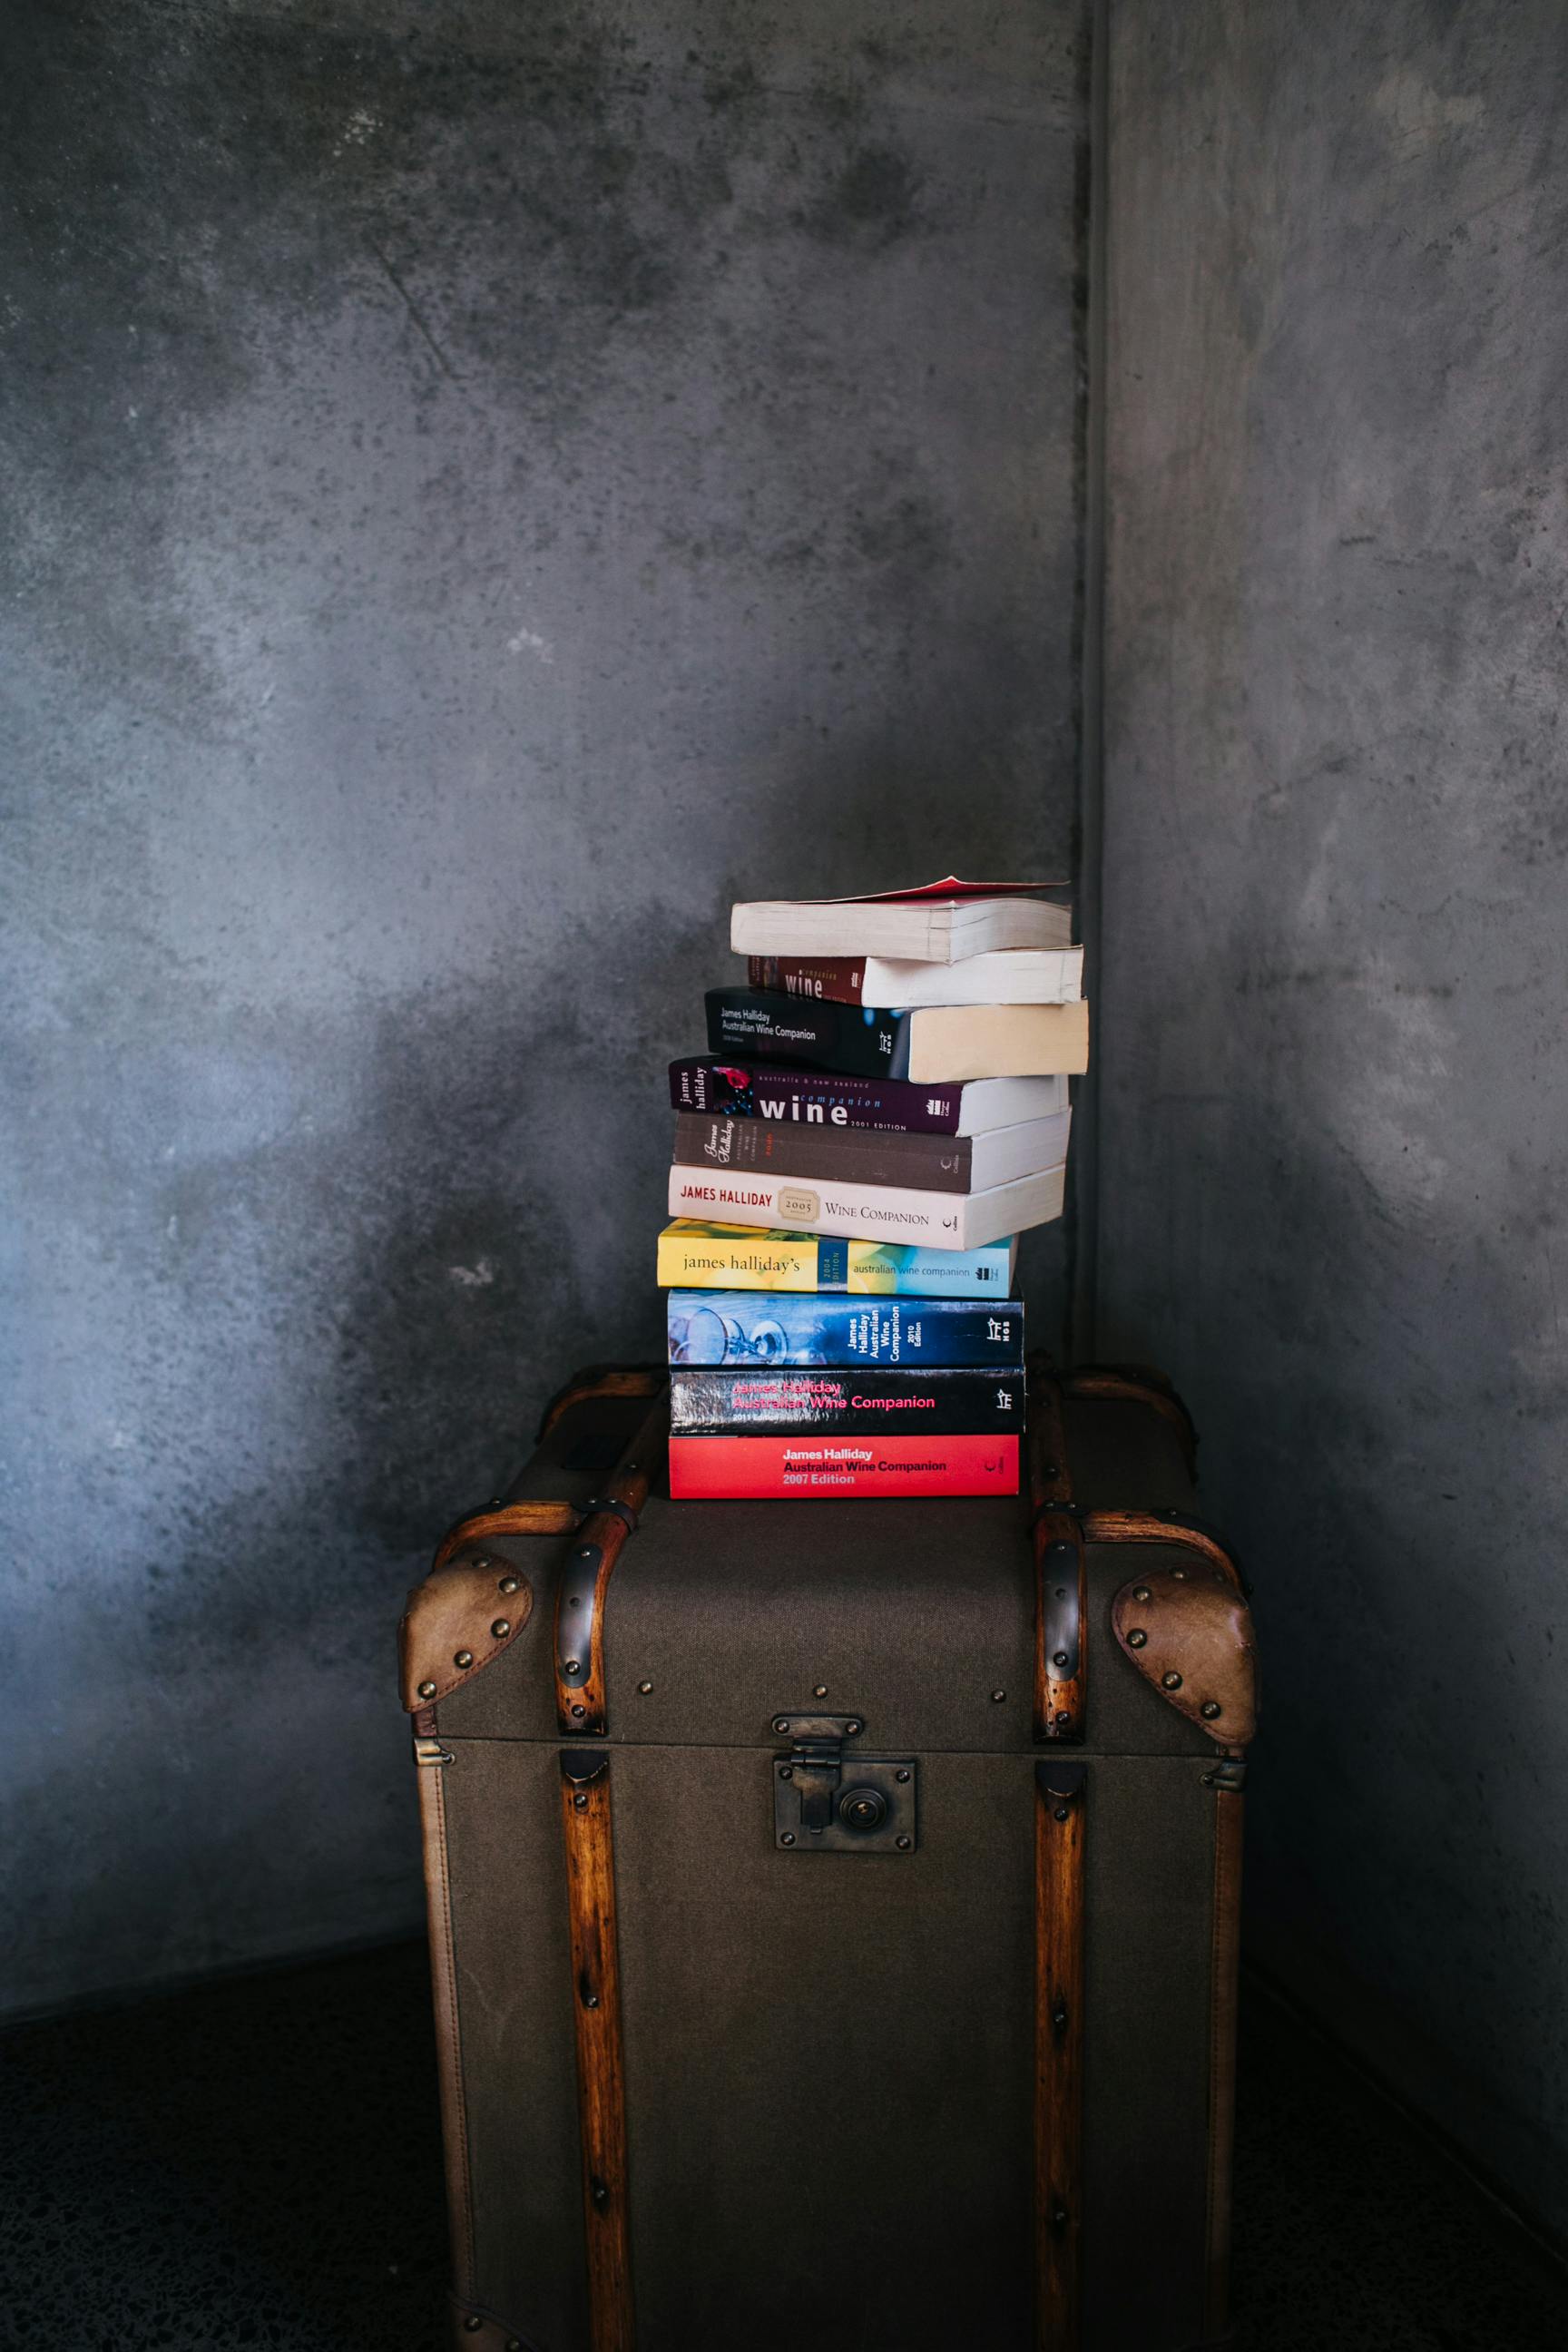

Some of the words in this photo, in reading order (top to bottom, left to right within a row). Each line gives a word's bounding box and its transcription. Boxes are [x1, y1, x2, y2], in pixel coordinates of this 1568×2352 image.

[785, 969, 823, 998] wine
[720, 1007, 742, 1019] James
[743, 1010, 770, 1024] Halliday
[722, 1022, 755, 1034] Australian
[756, 1024, 774, 1035] Wine
[775, 1025, 816, 1041] Companion
[681, 1072, 692, 1103] james
[694, 1067, 707, 1109] halliday
[759, 1095, 848, 1125] wine
[800, 1093, 882, 1109] companion
[851, 1120, 869, 1128] 2001
[874, 1122, 906, 1132] EDITION
[703, 1124, 718, 1157] James
[718, 1120, 735, 1162] Halliday
[681, 1185, 716, 1200] JAMES
[720, 1190, 772, 1207] HALLIDAY
[786, 1201, 812, 1212] 2005
[683, 1254, 726, 1270] james
[730, 1255, 800, 1275] halliday's
[853, 1264, 897, 1274] australian
[898, 1265, 920, 1275] wine
[922, 1267, 970, 1279] companion
[848, 1318, 857, 1350] James
[858, 1314, 870, 1353] Halliday
[869, 1309, 878, 1358] Australian
[880, 1321, 890, 1347] Wine
[890, 1306, 901, 1362] Companion
[732, 1381, 778, 1394] James
[782, 1380, 841, 1396] Halliday
[732, 1396, 805, 1408] Australian
[809, 1396, 848, 1408] Wine
[851, 1396, 936, 1412] Companion
[783, 1449, 822, 1460] James
[824, 1448, 873, 1461] Halliday
[784, 1462, 843, 1473] Australian
[846, 1461, 876, 1472] Wine
[877, 1460, 946, 1474] Companion
[783, 1475, 808, 1485] 2007
[811, 1474, 856, 1485] Edition
